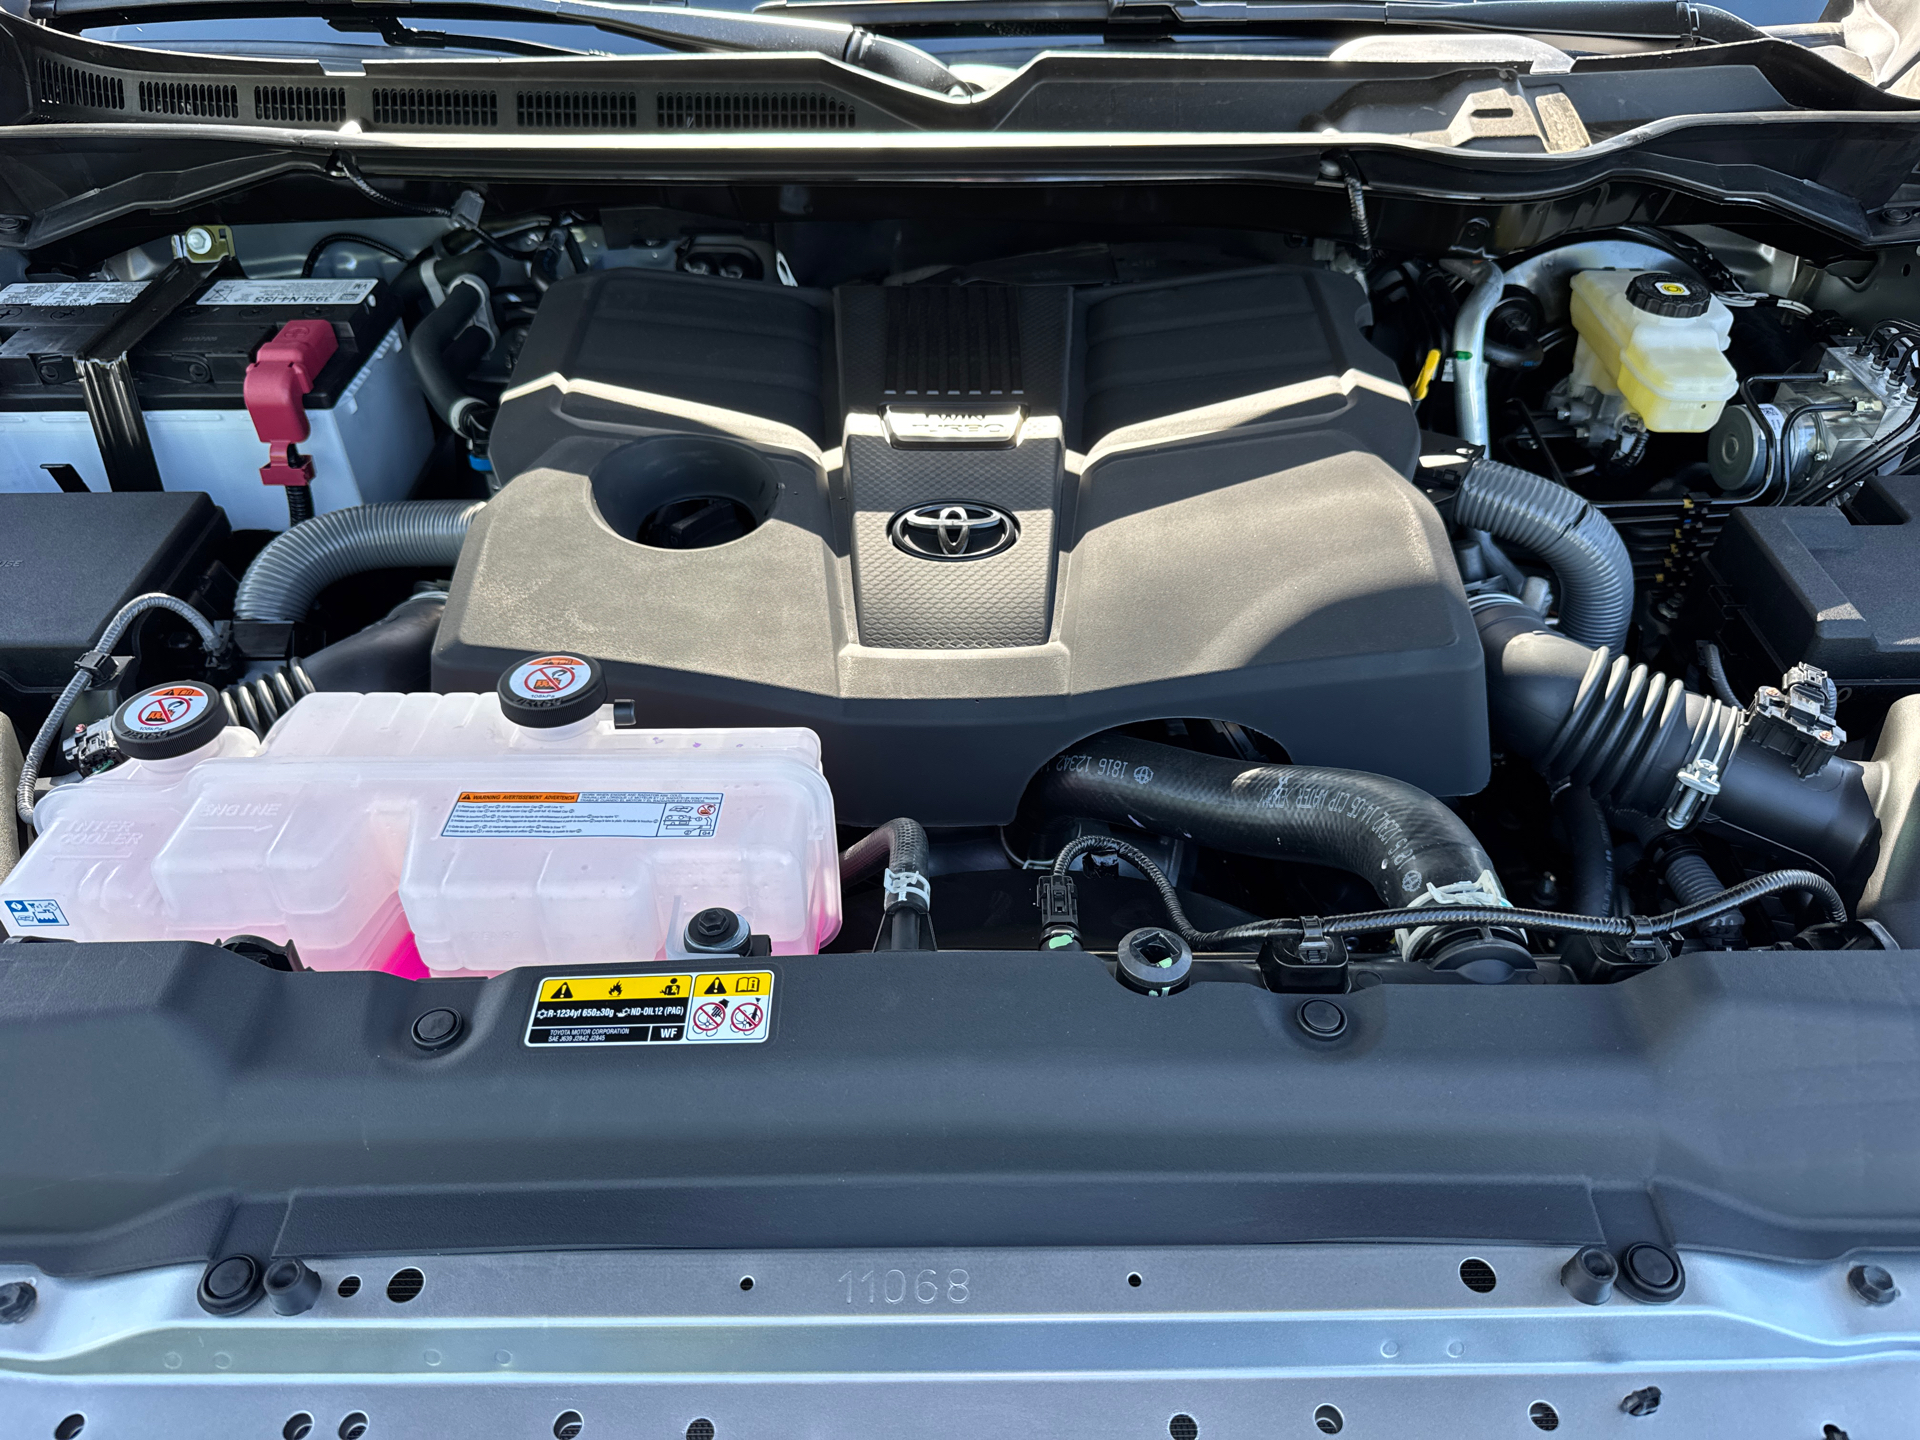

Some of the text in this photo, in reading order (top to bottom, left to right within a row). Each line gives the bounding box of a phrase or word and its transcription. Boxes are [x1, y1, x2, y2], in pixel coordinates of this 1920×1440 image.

[1056, 755, 1092, 773] 12342
[1097, 758, 1128, 779] 1816
[200, 803, 282, 817] ENGINE
[547, 1006, 684, 1018] R-1234yf 650±30g ND-OIL12 (PAG)
[660, 1028, 678, 1038] WF
[838, 1268, 970, 1305] 11068
